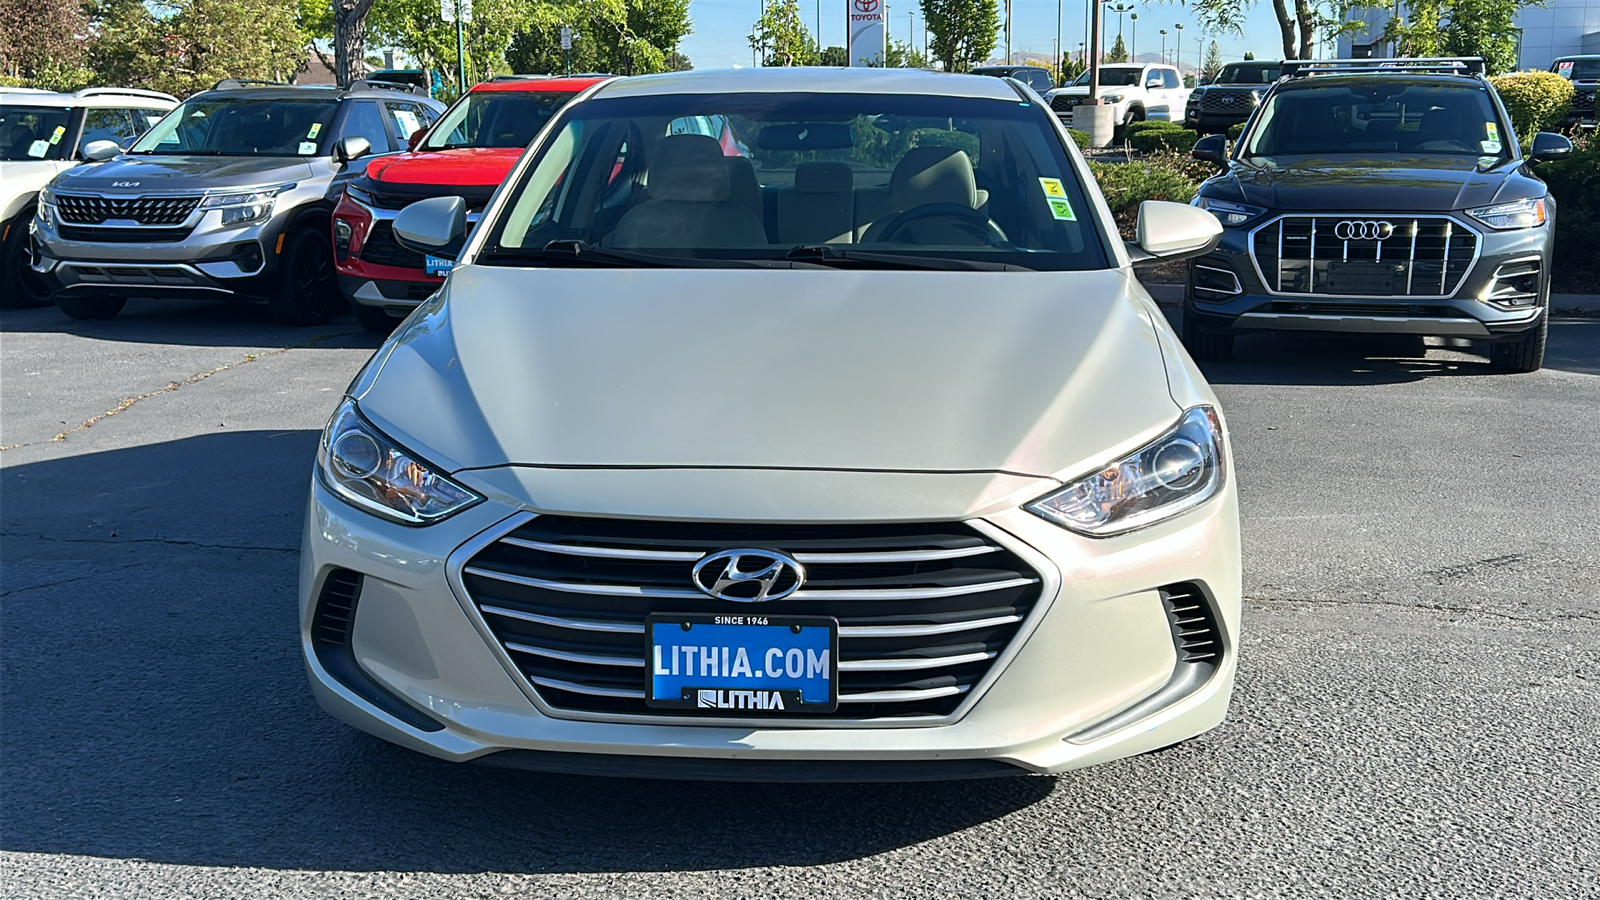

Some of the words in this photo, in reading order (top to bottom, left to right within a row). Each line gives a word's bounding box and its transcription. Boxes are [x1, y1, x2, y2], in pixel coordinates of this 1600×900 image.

[714, 616, 744, 625] SINCE
[746, 617, 769, 626] 1946
[653, 645, 830, 680] LITHIA.COM
[717, 690, 785, 710] LITHIA
